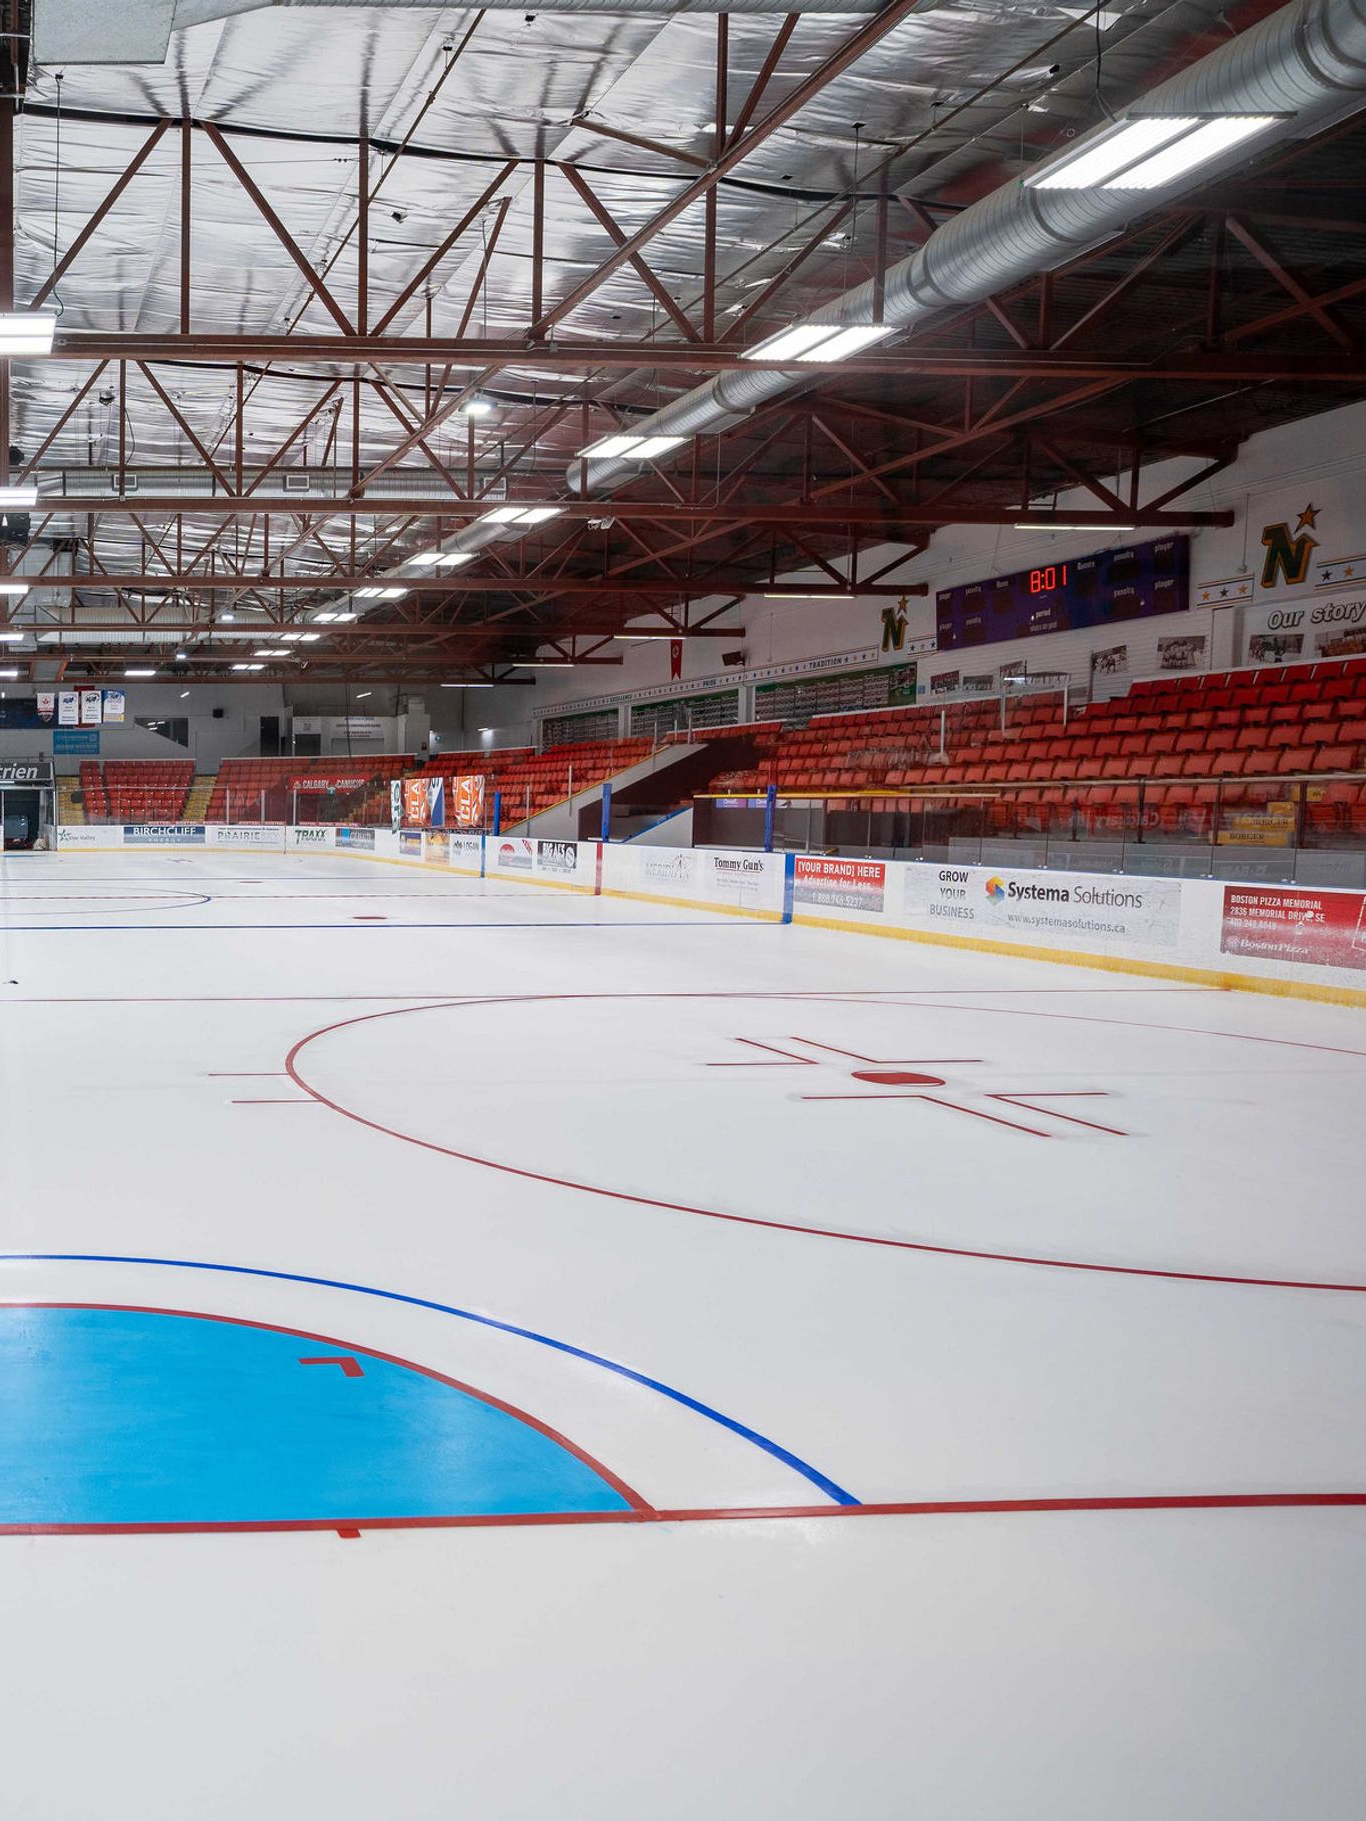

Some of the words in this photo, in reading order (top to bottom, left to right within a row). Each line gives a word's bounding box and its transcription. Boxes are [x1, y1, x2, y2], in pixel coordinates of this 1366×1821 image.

[1030, 565, 1067, 593] 8:01
[1268, 609, 1304, 630] Our
[1310, 600, 1366, 623] story
[808, 657, 842, 669] TRADITION
[133, 827, 196, 836] BIRCHCLIFF
[714, 857, 741, 870] Tommy
[743, 859, 764, 871] Gun's
[857, 866, 880, 878] HERE
[938, 870, 969, 883] GROW
[940, 887, 966, 899] YOUR
[1008, 881, 1070, 902] Systema
[1074, 886, 1142, 908] Solutions
[1231, 894, 1258, 904] BOSTON
[1259, 897, 1282, 906] PIZZA
[1283, 898, 1323, 910] MEMORIAL
[929, 903, 975, 920] BUSINESS
[1249, 908, 1286, 919] MEMORIAL
[1288, 910, 1314, 922] DRIV
[1007, 912, 1126, 934] www.systemasolutions.ca
